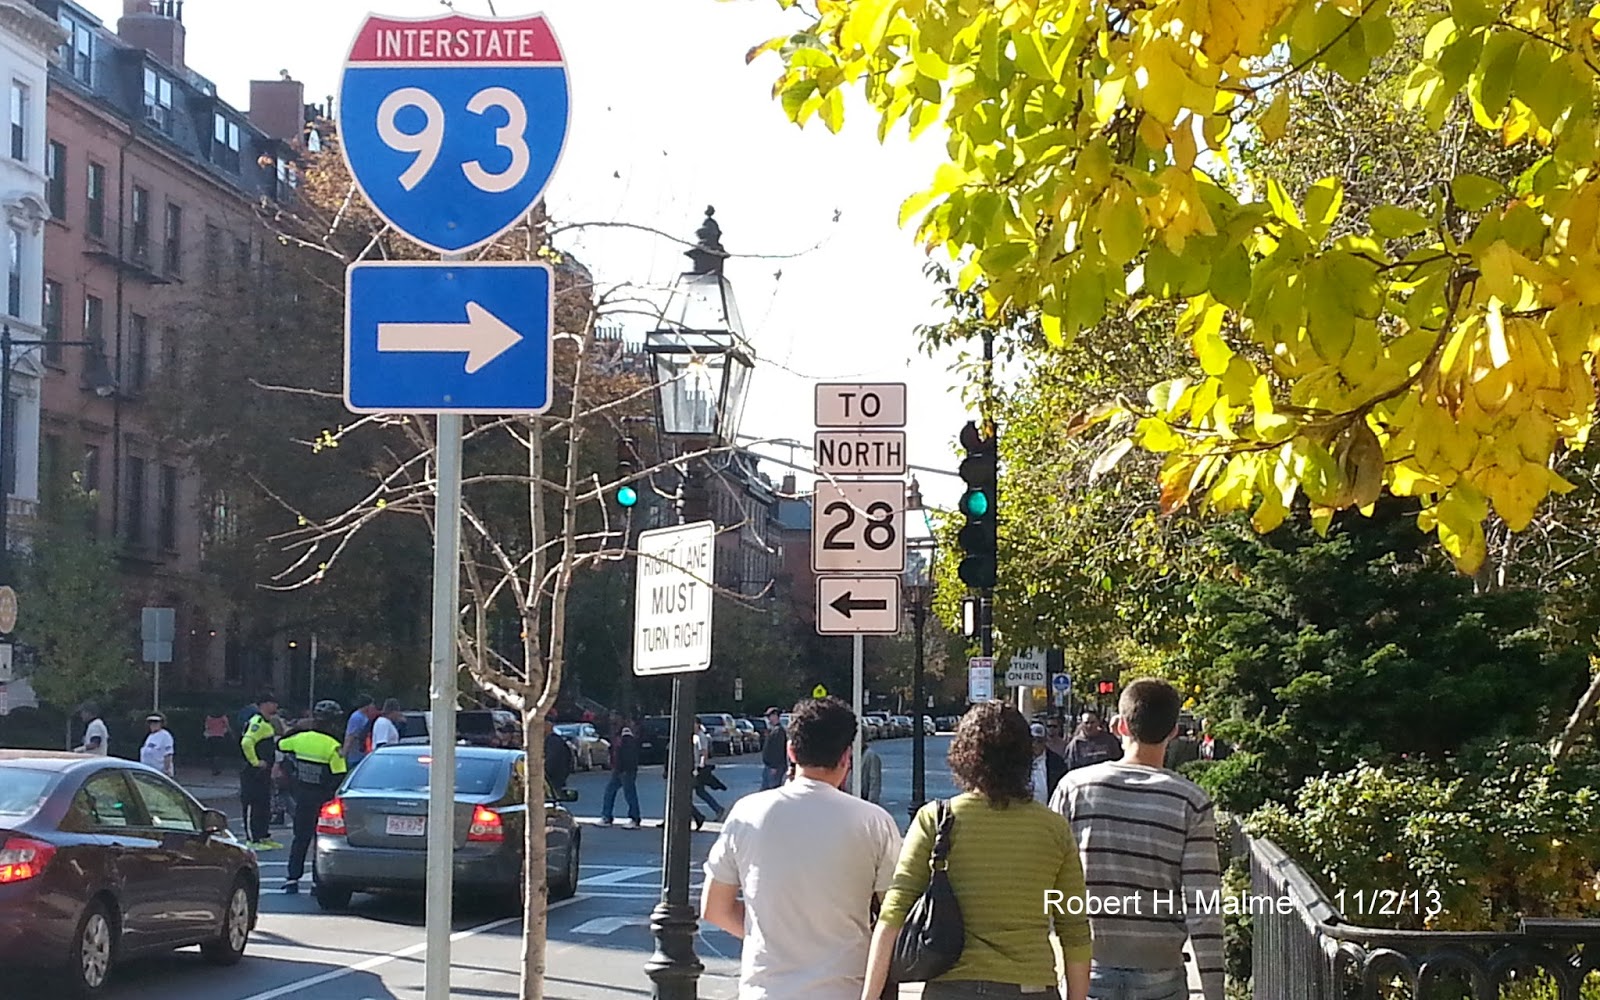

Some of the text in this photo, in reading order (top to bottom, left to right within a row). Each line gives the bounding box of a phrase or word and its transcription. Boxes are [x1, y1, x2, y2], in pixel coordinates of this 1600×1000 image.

[376, 29, 534, 58] INTERSTATE
[376, 86, 530, 193] 93
[838, 392, 881, 418] TO
[819, 439, 901, 467] NORTH
[822, 502, 896, 551] 28
[652, 581, 697, 616] MUST
[643, 621, 705, 653] TURN RIGHT
[1008, 672, 1043, 681] ON RED
[1013, 662, 1039, 671] TURN
